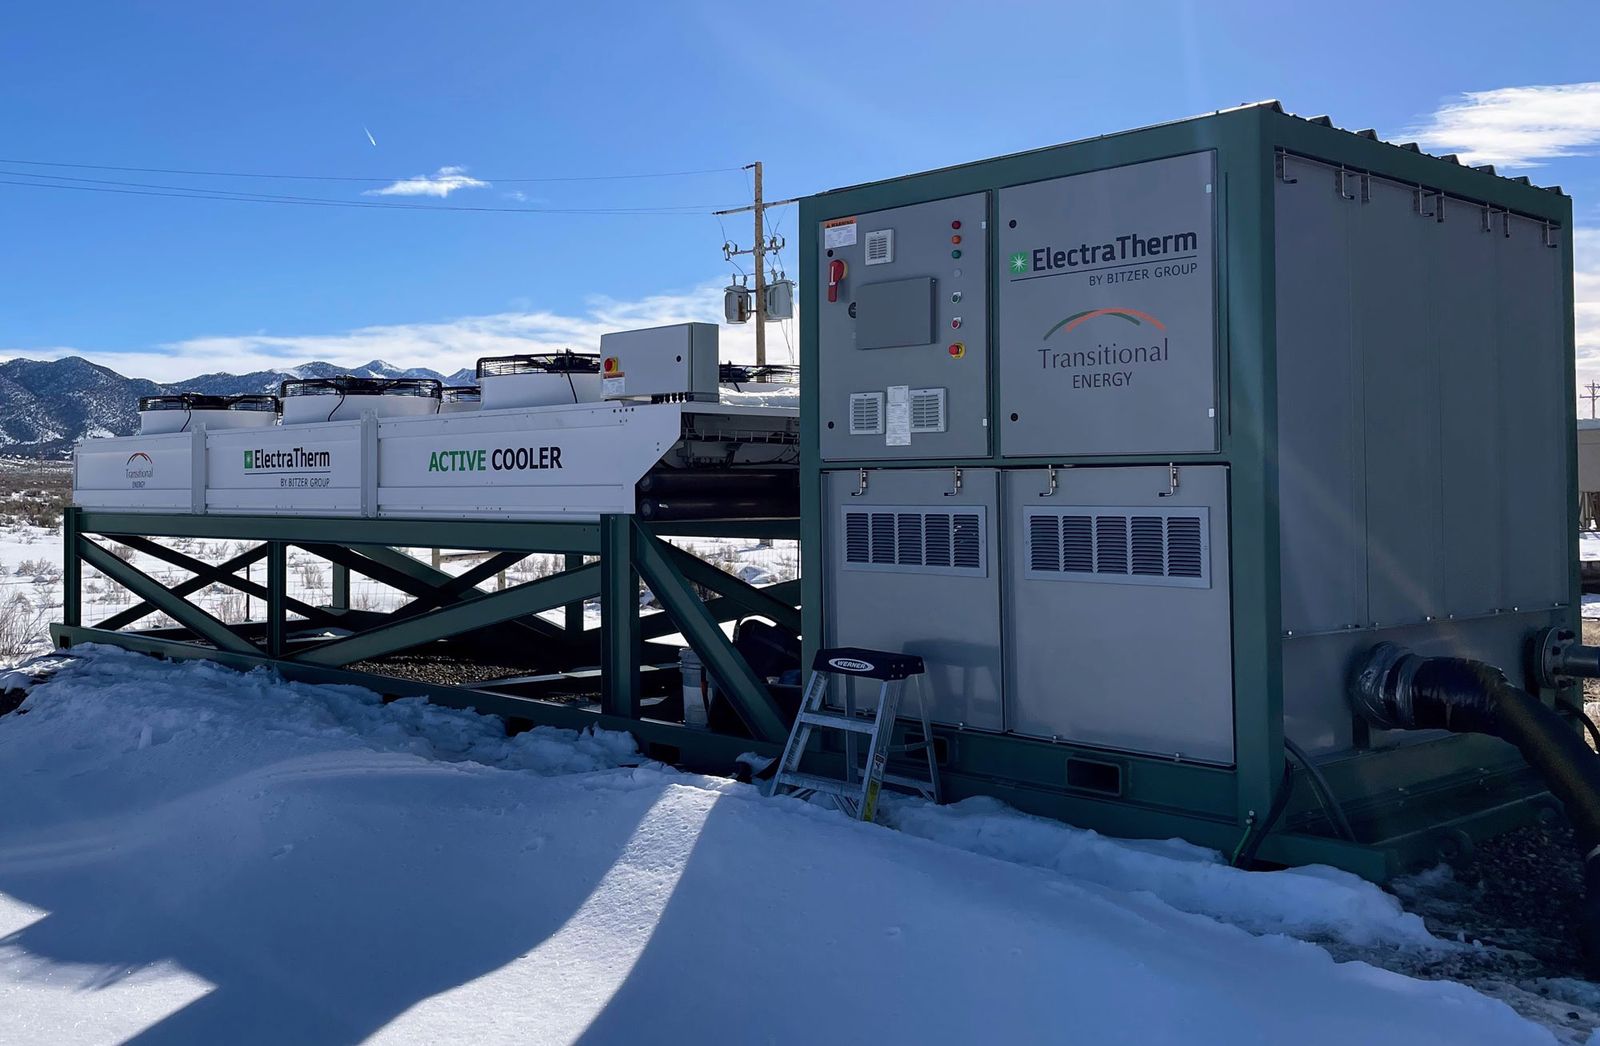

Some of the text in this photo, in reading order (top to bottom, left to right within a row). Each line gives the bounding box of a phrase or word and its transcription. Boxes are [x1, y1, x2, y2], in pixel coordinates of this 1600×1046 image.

[1033, 232, 1197, 271] ElectraTherm
[1089, 263, 1198, 286] BY BITZER GROUP
[1038, 338, 1168, 369] Transitional
[1073, 372, 1132, 388] ENERGY
[255, 447, 330, 469] ElectraTherm
[429, 447, 563, 472] ACTIVE COOLER
[280, 477, 330, 487] BY BITZER GROUP
[837, 660, 866, 669] WERNER
